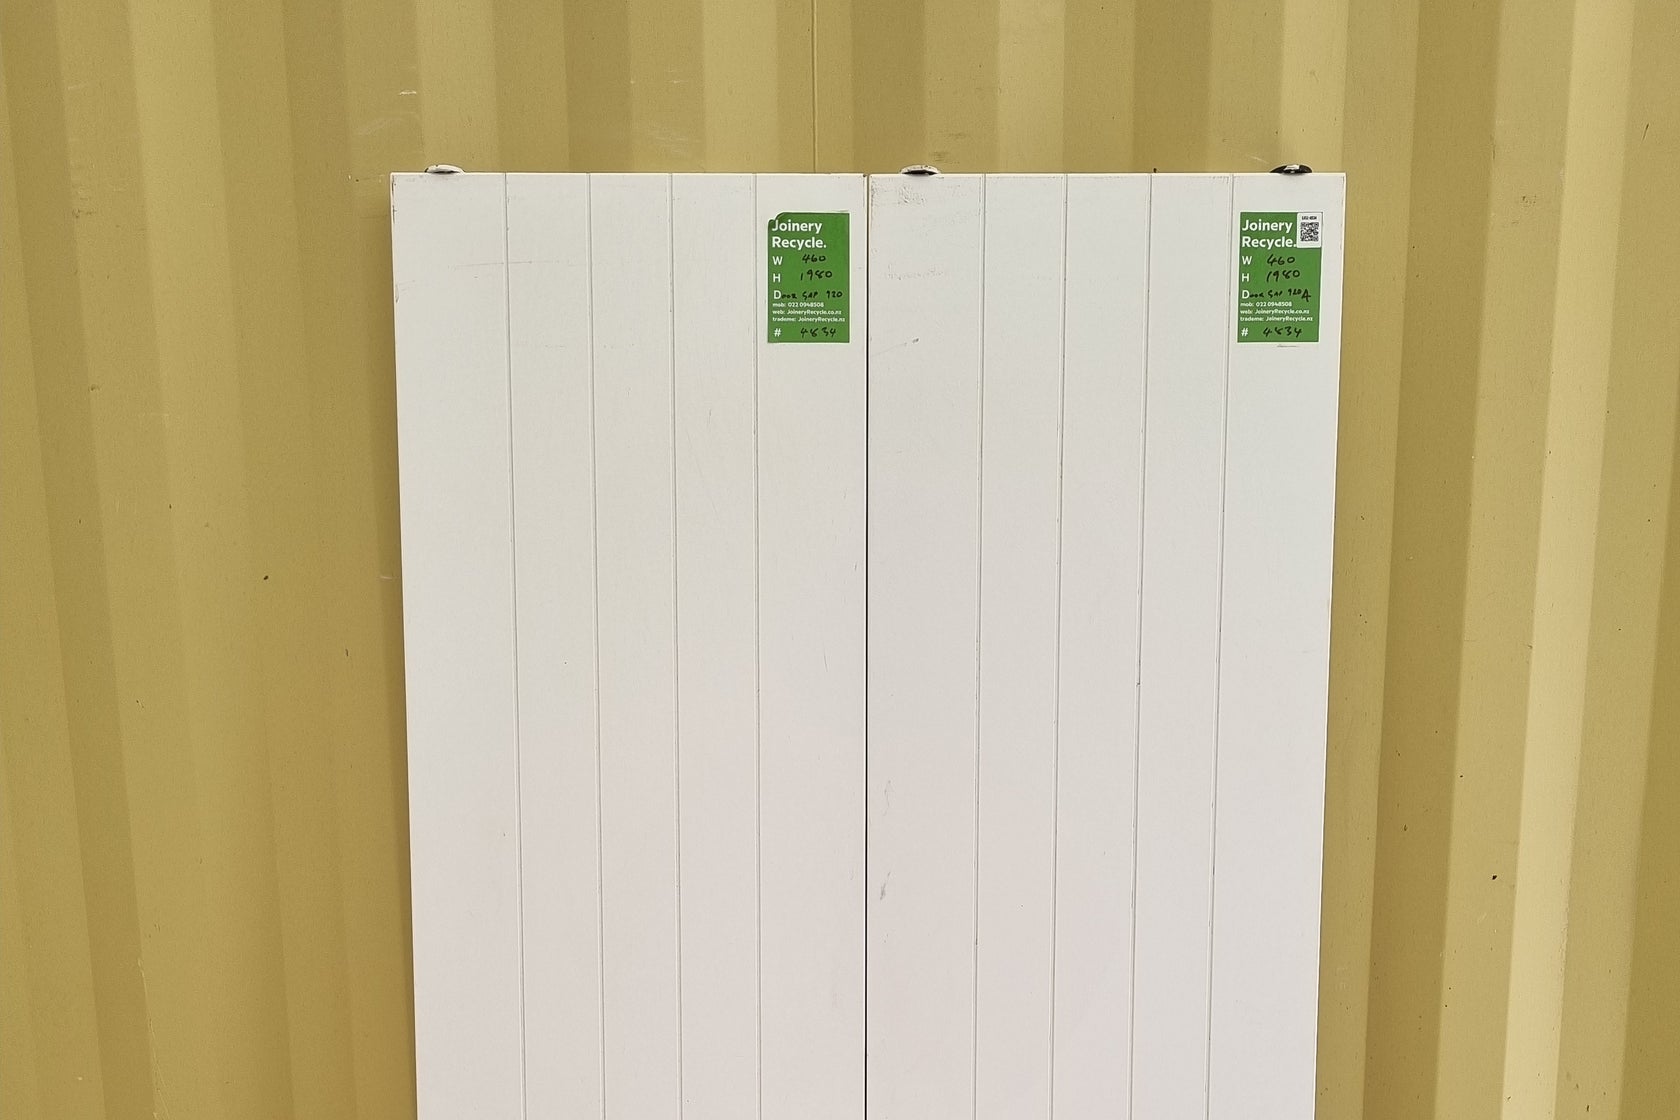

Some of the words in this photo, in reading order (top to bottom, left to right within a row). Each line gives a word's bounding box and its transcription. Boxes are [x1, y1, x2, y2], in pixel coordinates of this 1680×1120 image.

[772, 219, 823, 234] Joinery
[1241, 219, 1293, 234] Joinery
[772, 236, 827, 251] Recycle.
[1241, 236, 1297, 250] Recycle.
[772, 256, 783, 266] W
[802, 254, 826, 264] 460
[1241, 255, 1252, 265] W
[1266, 254, 1296, 267] 460
[772, 273, 781, 283] H
[800, 269, 833, 281] 1980
[1241, 273, 1250, 282] H
[1266, 269, 1300, 283] 1980
[773, 328, 782, 337] #
[1241, 328, 1249, 337] #
